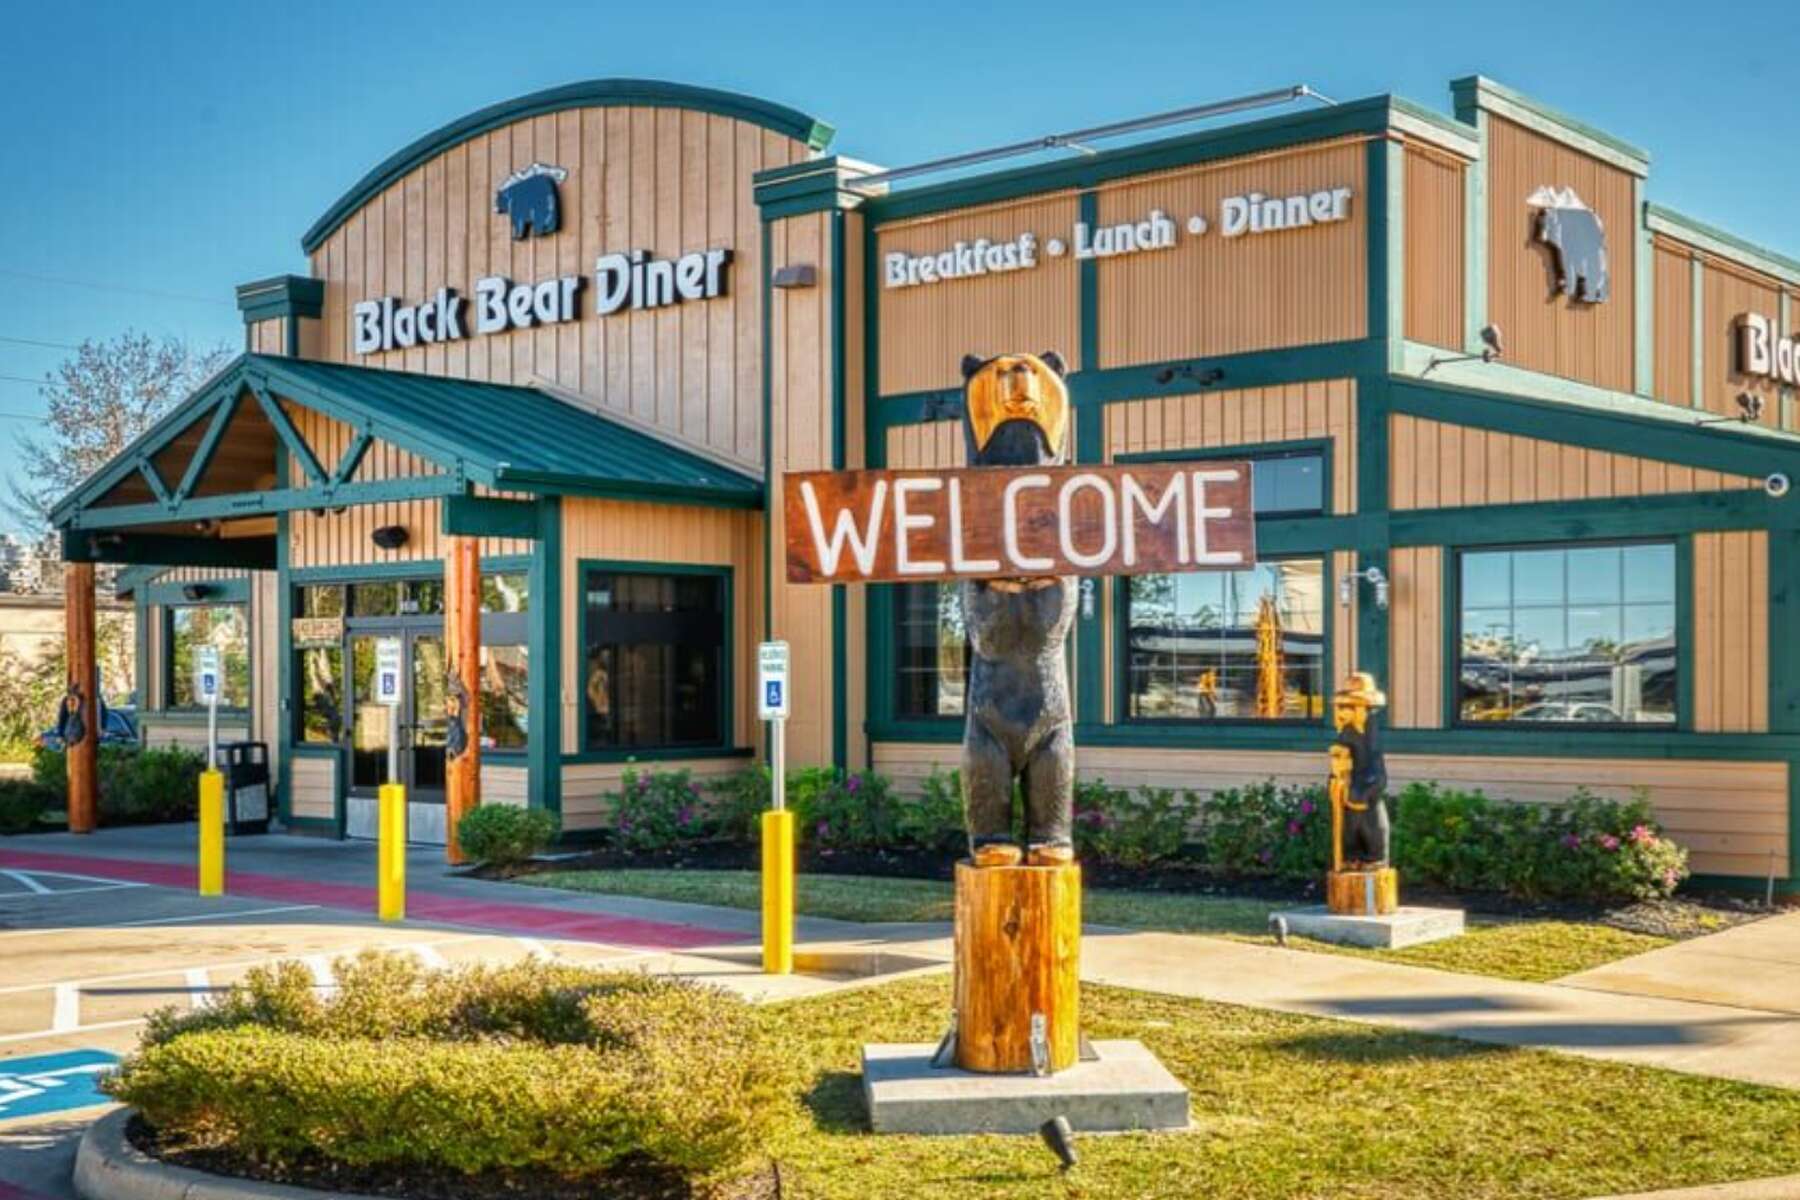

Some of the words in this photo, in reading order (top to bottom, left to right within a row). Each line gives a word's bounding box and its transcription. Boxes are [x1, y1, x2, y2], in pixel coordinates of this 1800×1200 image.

[884, 232, 1038, 289] Breakfast
[1074, 210, 1177, 259] Lunch
[1221, 187, 1352, 237] Dinner
[355, 287, 463, 354] Black
[475, 275, 579, 334] Bear
[596, 249, 726, 315] Diner
[800, 469, 1244, 577] WELCOME
